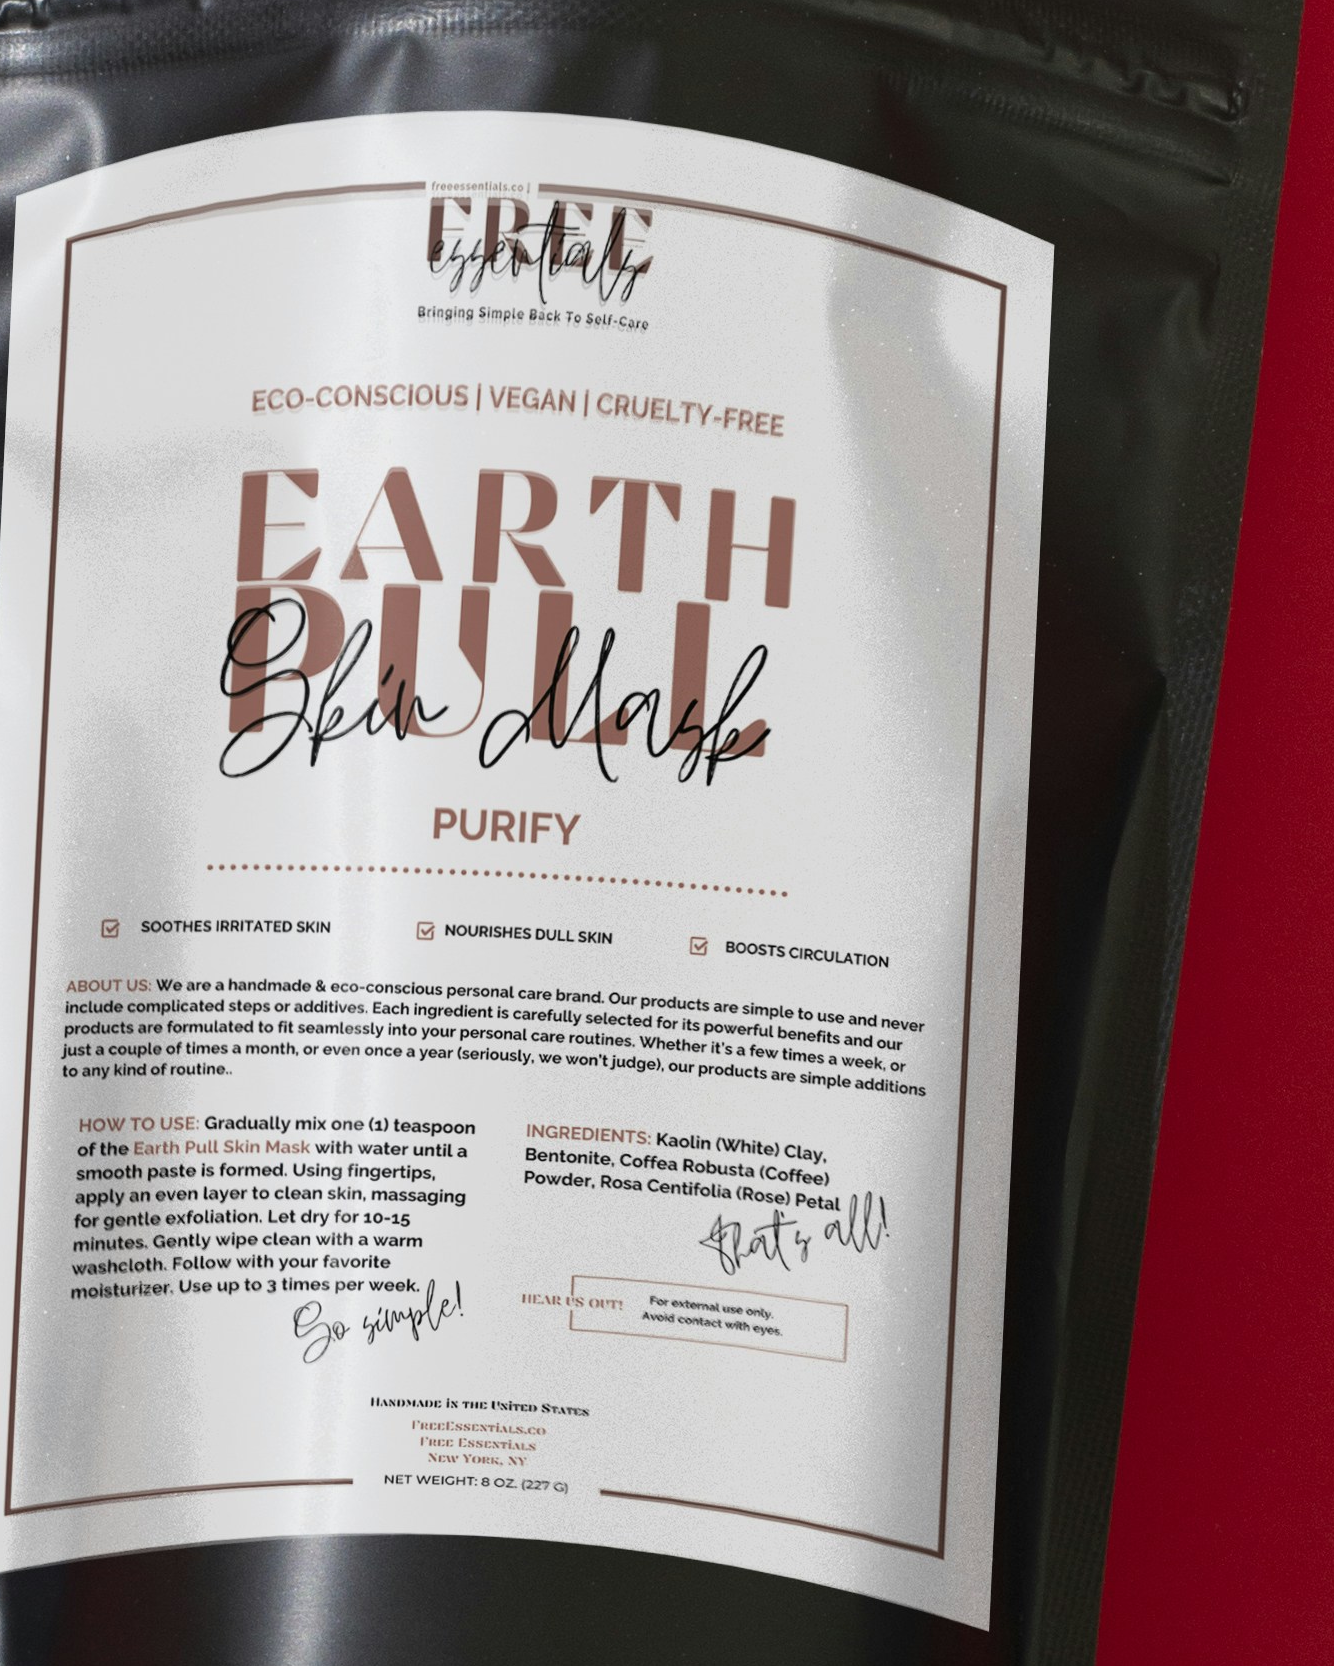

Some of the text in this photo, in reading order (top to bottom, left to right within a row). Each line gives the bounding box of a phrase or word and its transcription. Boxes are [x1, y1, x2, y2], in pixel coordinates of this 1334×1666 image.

[426, 196, 654, 274] FREE
[429, 200, 648, 305] essentials
[417, 305, 649, 331] Bringing Simple Back To Self-Care
[252, 384, 784, 438] ECO-CONSCIOUS VEGAN CRUELTY-FREE
[236, 466, 797, 609] EARTH
[229, 583, 767, 757] PULL
[219, 598, 772, 787] Skin Mask
[433, 807, 582, 846] PURIFY
[140, 919, 332, 934] SOOTHES IRRITATED SKIN
[444, 924, 614, 945] NOURISHES DULL SKIN
[725, 940, 890, 969] BOOSTS CIRCULATION
[66, 978, 926, 1033] ABOUT US: We are a handmade & eco-conscious personal care brand. Our products are simple to use and never
[64, 998, 904, 1052] include complicated steps or additives. Each ingredient is carefully selected for its powerful benefits and our
[62, 1064, 79, 1078] to
[81, 1066, 110, 1080] any
[113, 1062, 148, 1077] kind
[150, 1062, 168, 1076] of
[79, 1115, 476, 1138] HOW TO USE: Gradually mix one (1) teaspoon
[76, 1140, 468, 1159] of the Earth Pull Skin Mask with water until a
[526, 1124, 828, 1166] INGREDIENTS: Kaolin (White) Clay,
[76, 1162, 436, 1183] smooth paste is formed. Using fingertips,
[524, 1146, 830, 1187] Bentonite, Coffea Robusta (Coffee)
[74, 1185, 467, 1208] apply an even layer to clean skin, massaging
[523, 1169, 841, 1212] Powder, Rosa Centifolia (Rose) Petal
[74, 1208, 411, 1232] for gentle exfoliation. Let dry for 10-15
[521, 1292, 562, 1307] HEAR
[649, 1295, 774, 1321] For external use only.
[293, 1300, 351, 1364] So
[642, 1311, 784, 1337] Avoid contact with eyes.
[384, 1474, 568, 1494] NET WEIGHT: 8 OZ. (227 G)
